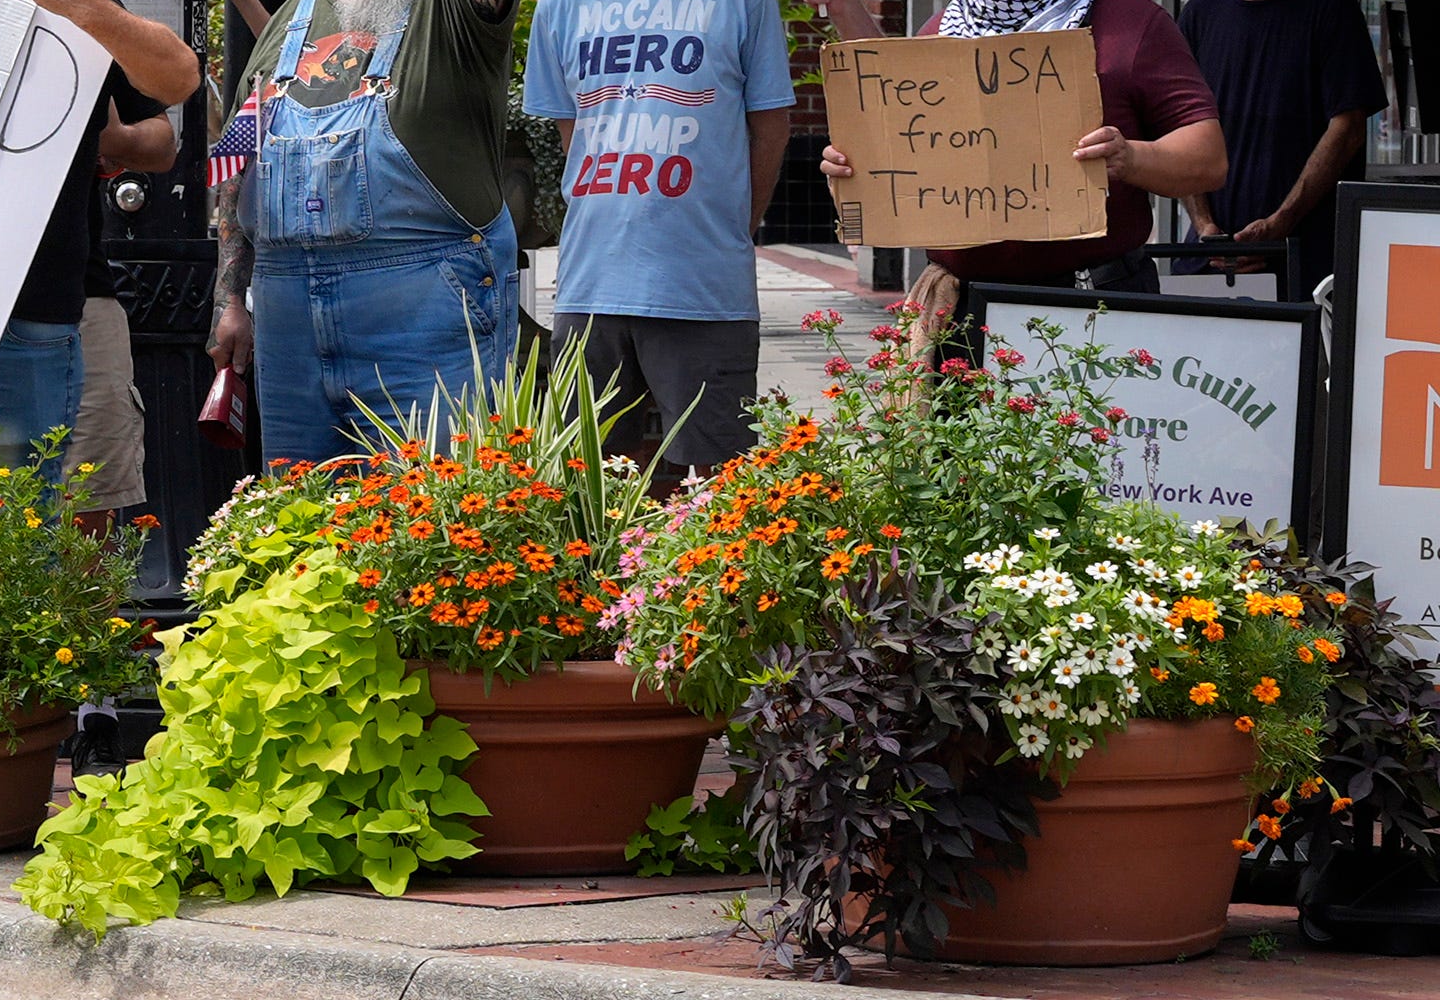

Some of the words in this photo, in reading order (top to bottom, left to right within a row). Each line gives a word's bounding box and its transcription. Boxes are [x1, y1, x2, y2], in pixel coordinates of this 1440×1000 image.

[578, 34, 705, 80] HERO
[854, 49, 945, 112] Free
[975, 46, 1065, 94] USA
[576, 112, 699, 154] TRUMP
[899, 114, 998, 153] from
[869, 163, 1051, 223] Trump!!
[1172, 355, 1278, 433] Guild
[1148, 483, 1203, 504] York
[1209, 485, 1254, 508] Ave
